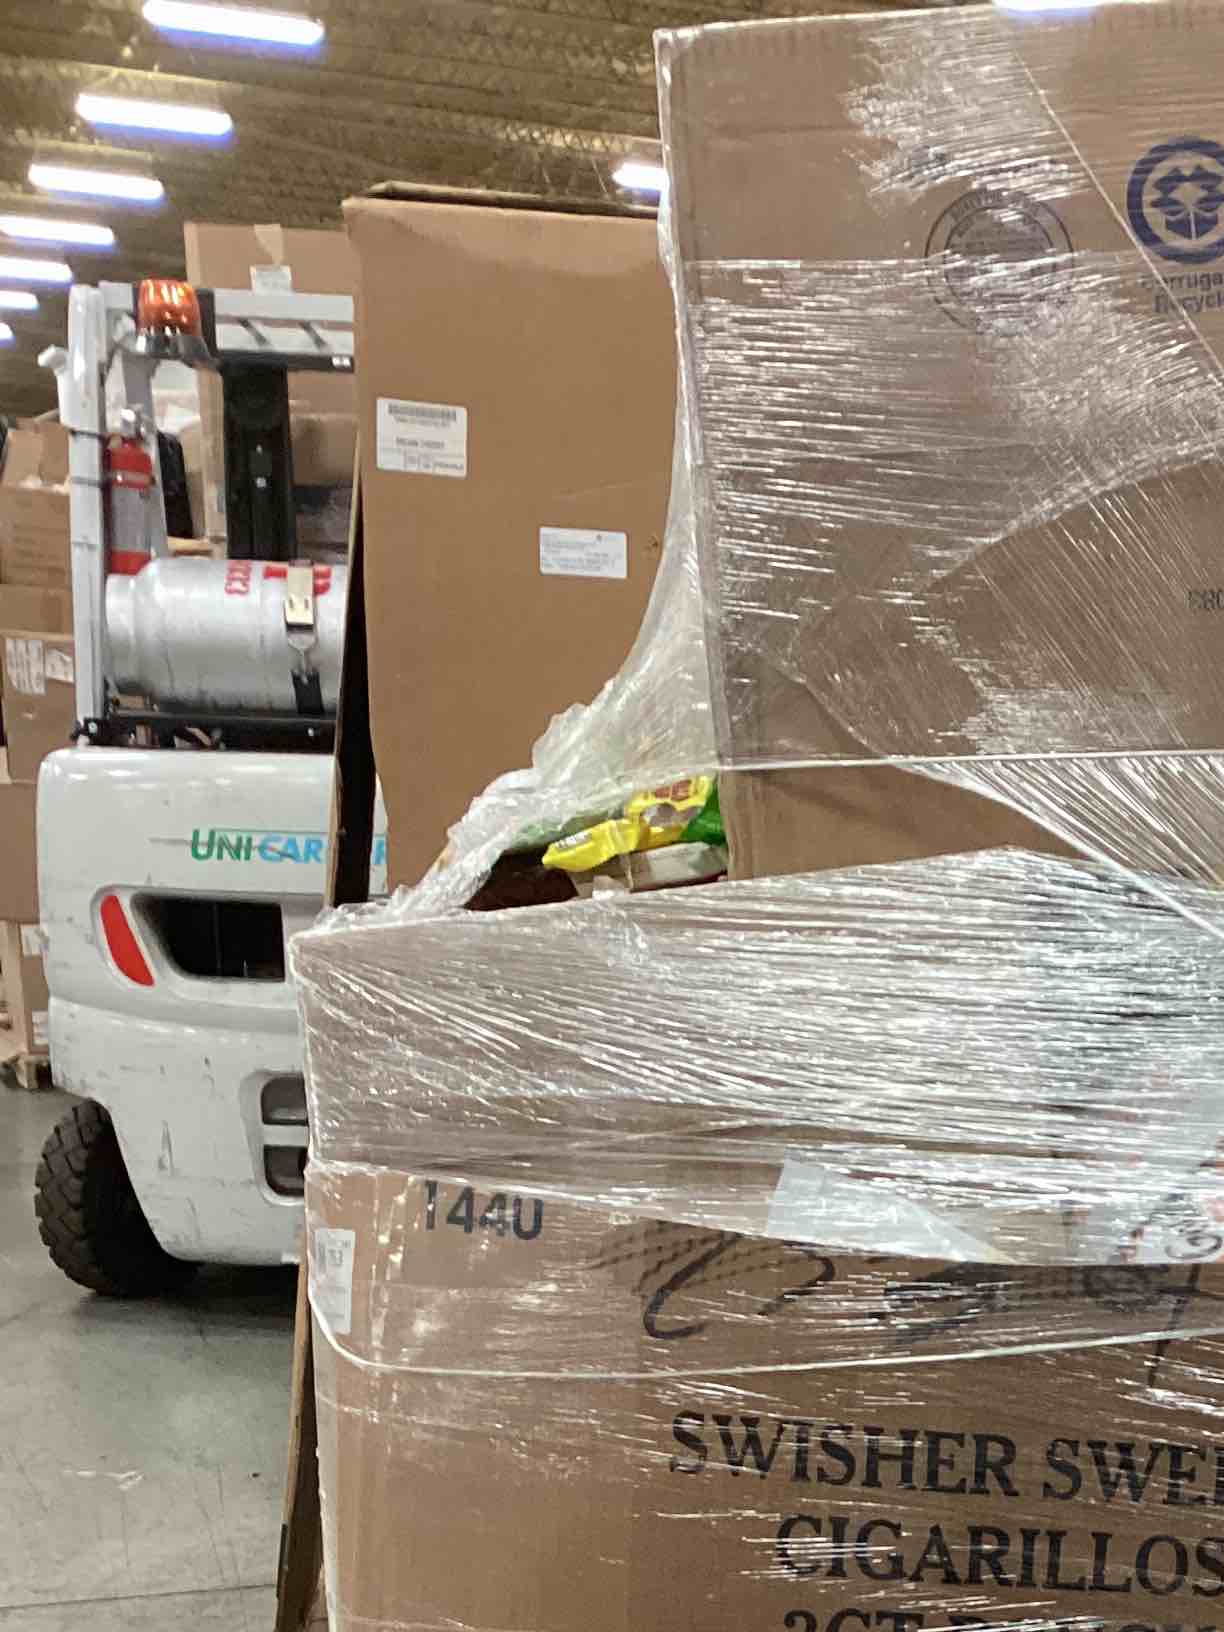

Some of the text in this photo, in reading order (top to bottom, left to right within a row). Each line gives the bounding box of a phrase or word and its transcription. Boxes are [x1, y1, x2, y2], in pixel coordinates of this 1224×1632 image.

[191, 828, 388, 865] UNICAR
[422, 1178, 546, 1242] 1440
[670, 1410, 1020, 1497] SWISHER
